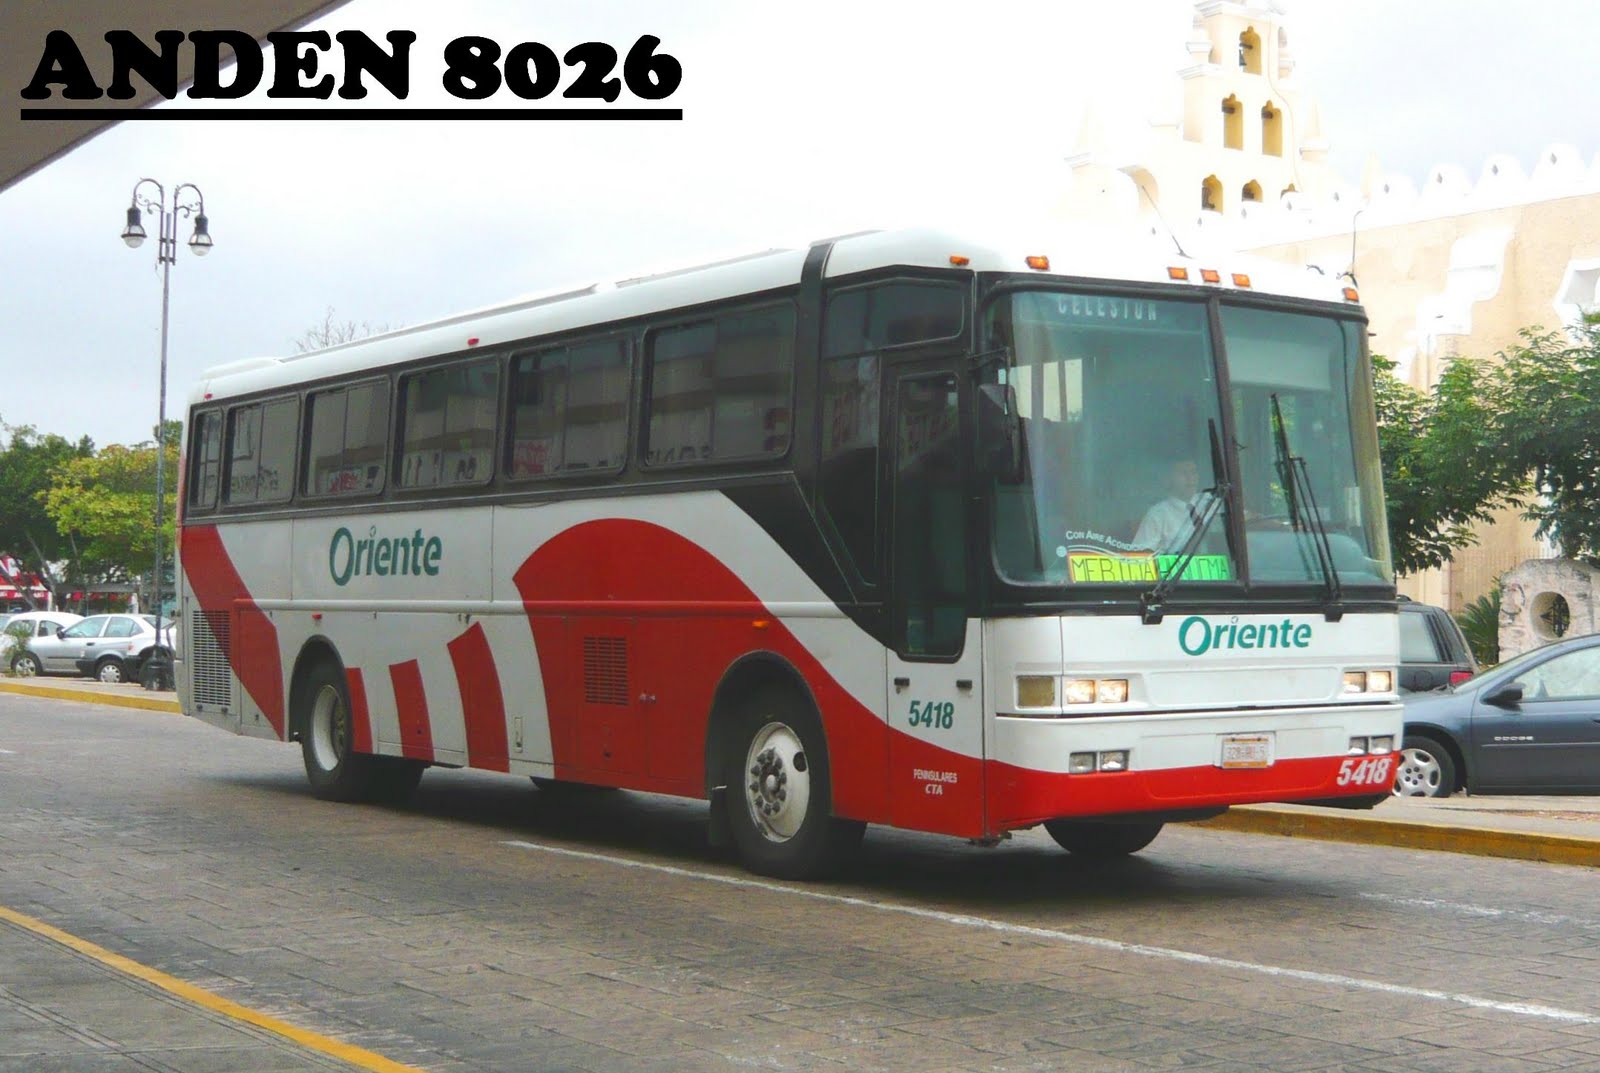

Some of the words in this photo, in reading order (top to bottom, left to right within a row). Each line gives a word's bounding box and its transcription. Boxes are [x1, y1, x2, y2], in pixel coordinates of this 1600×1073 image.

[329, 526, 443, 586] Oriente
[1178, 615, 1312, 656] Oriente
[908, 700, 954, 729] 5418
[1336, 757, 1393, 786] 5418
[925, 783, 944, 796] CTA
